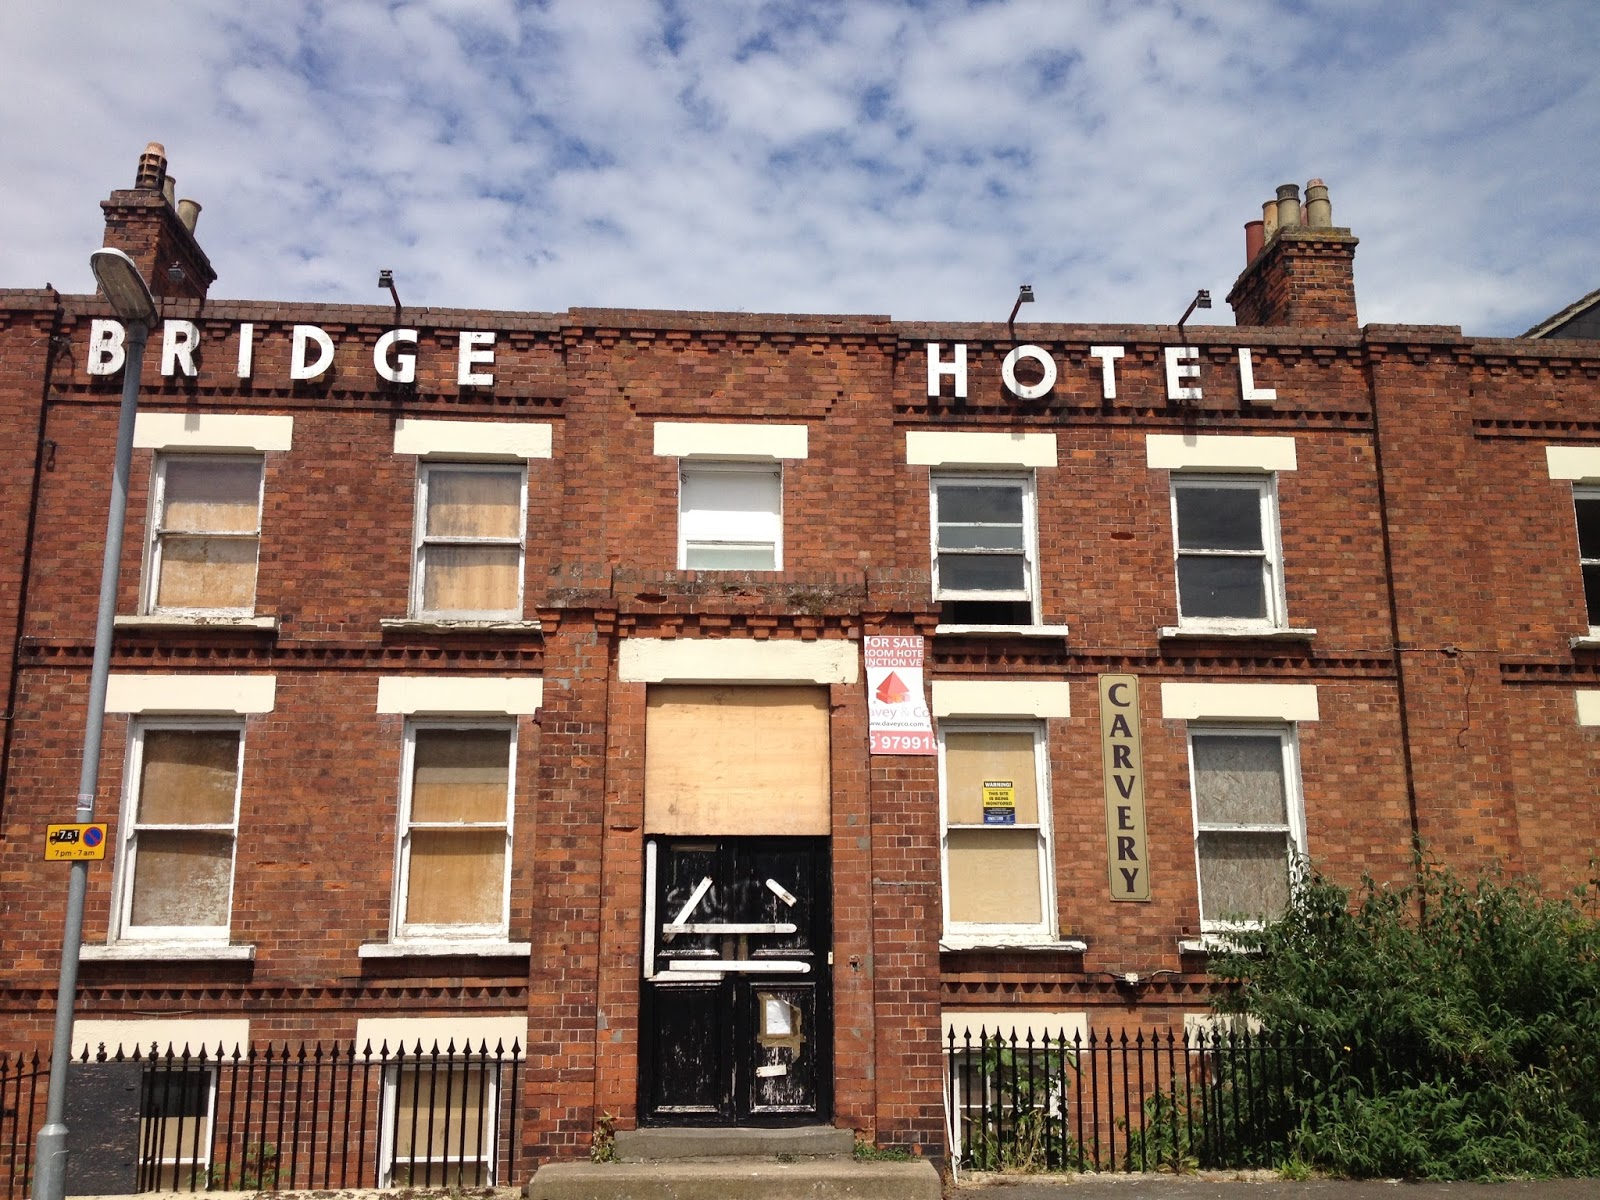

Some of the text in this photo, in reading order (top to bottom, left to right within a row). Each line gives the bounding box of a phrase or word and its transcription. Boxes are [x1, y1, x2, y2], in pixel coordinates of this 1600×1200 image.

[86, 318, 1277, 400] BRIDGE HOTEL
[864, 637, 923, 648] FOR SALE
[1108, 682, 1139, 893] CARVERY
